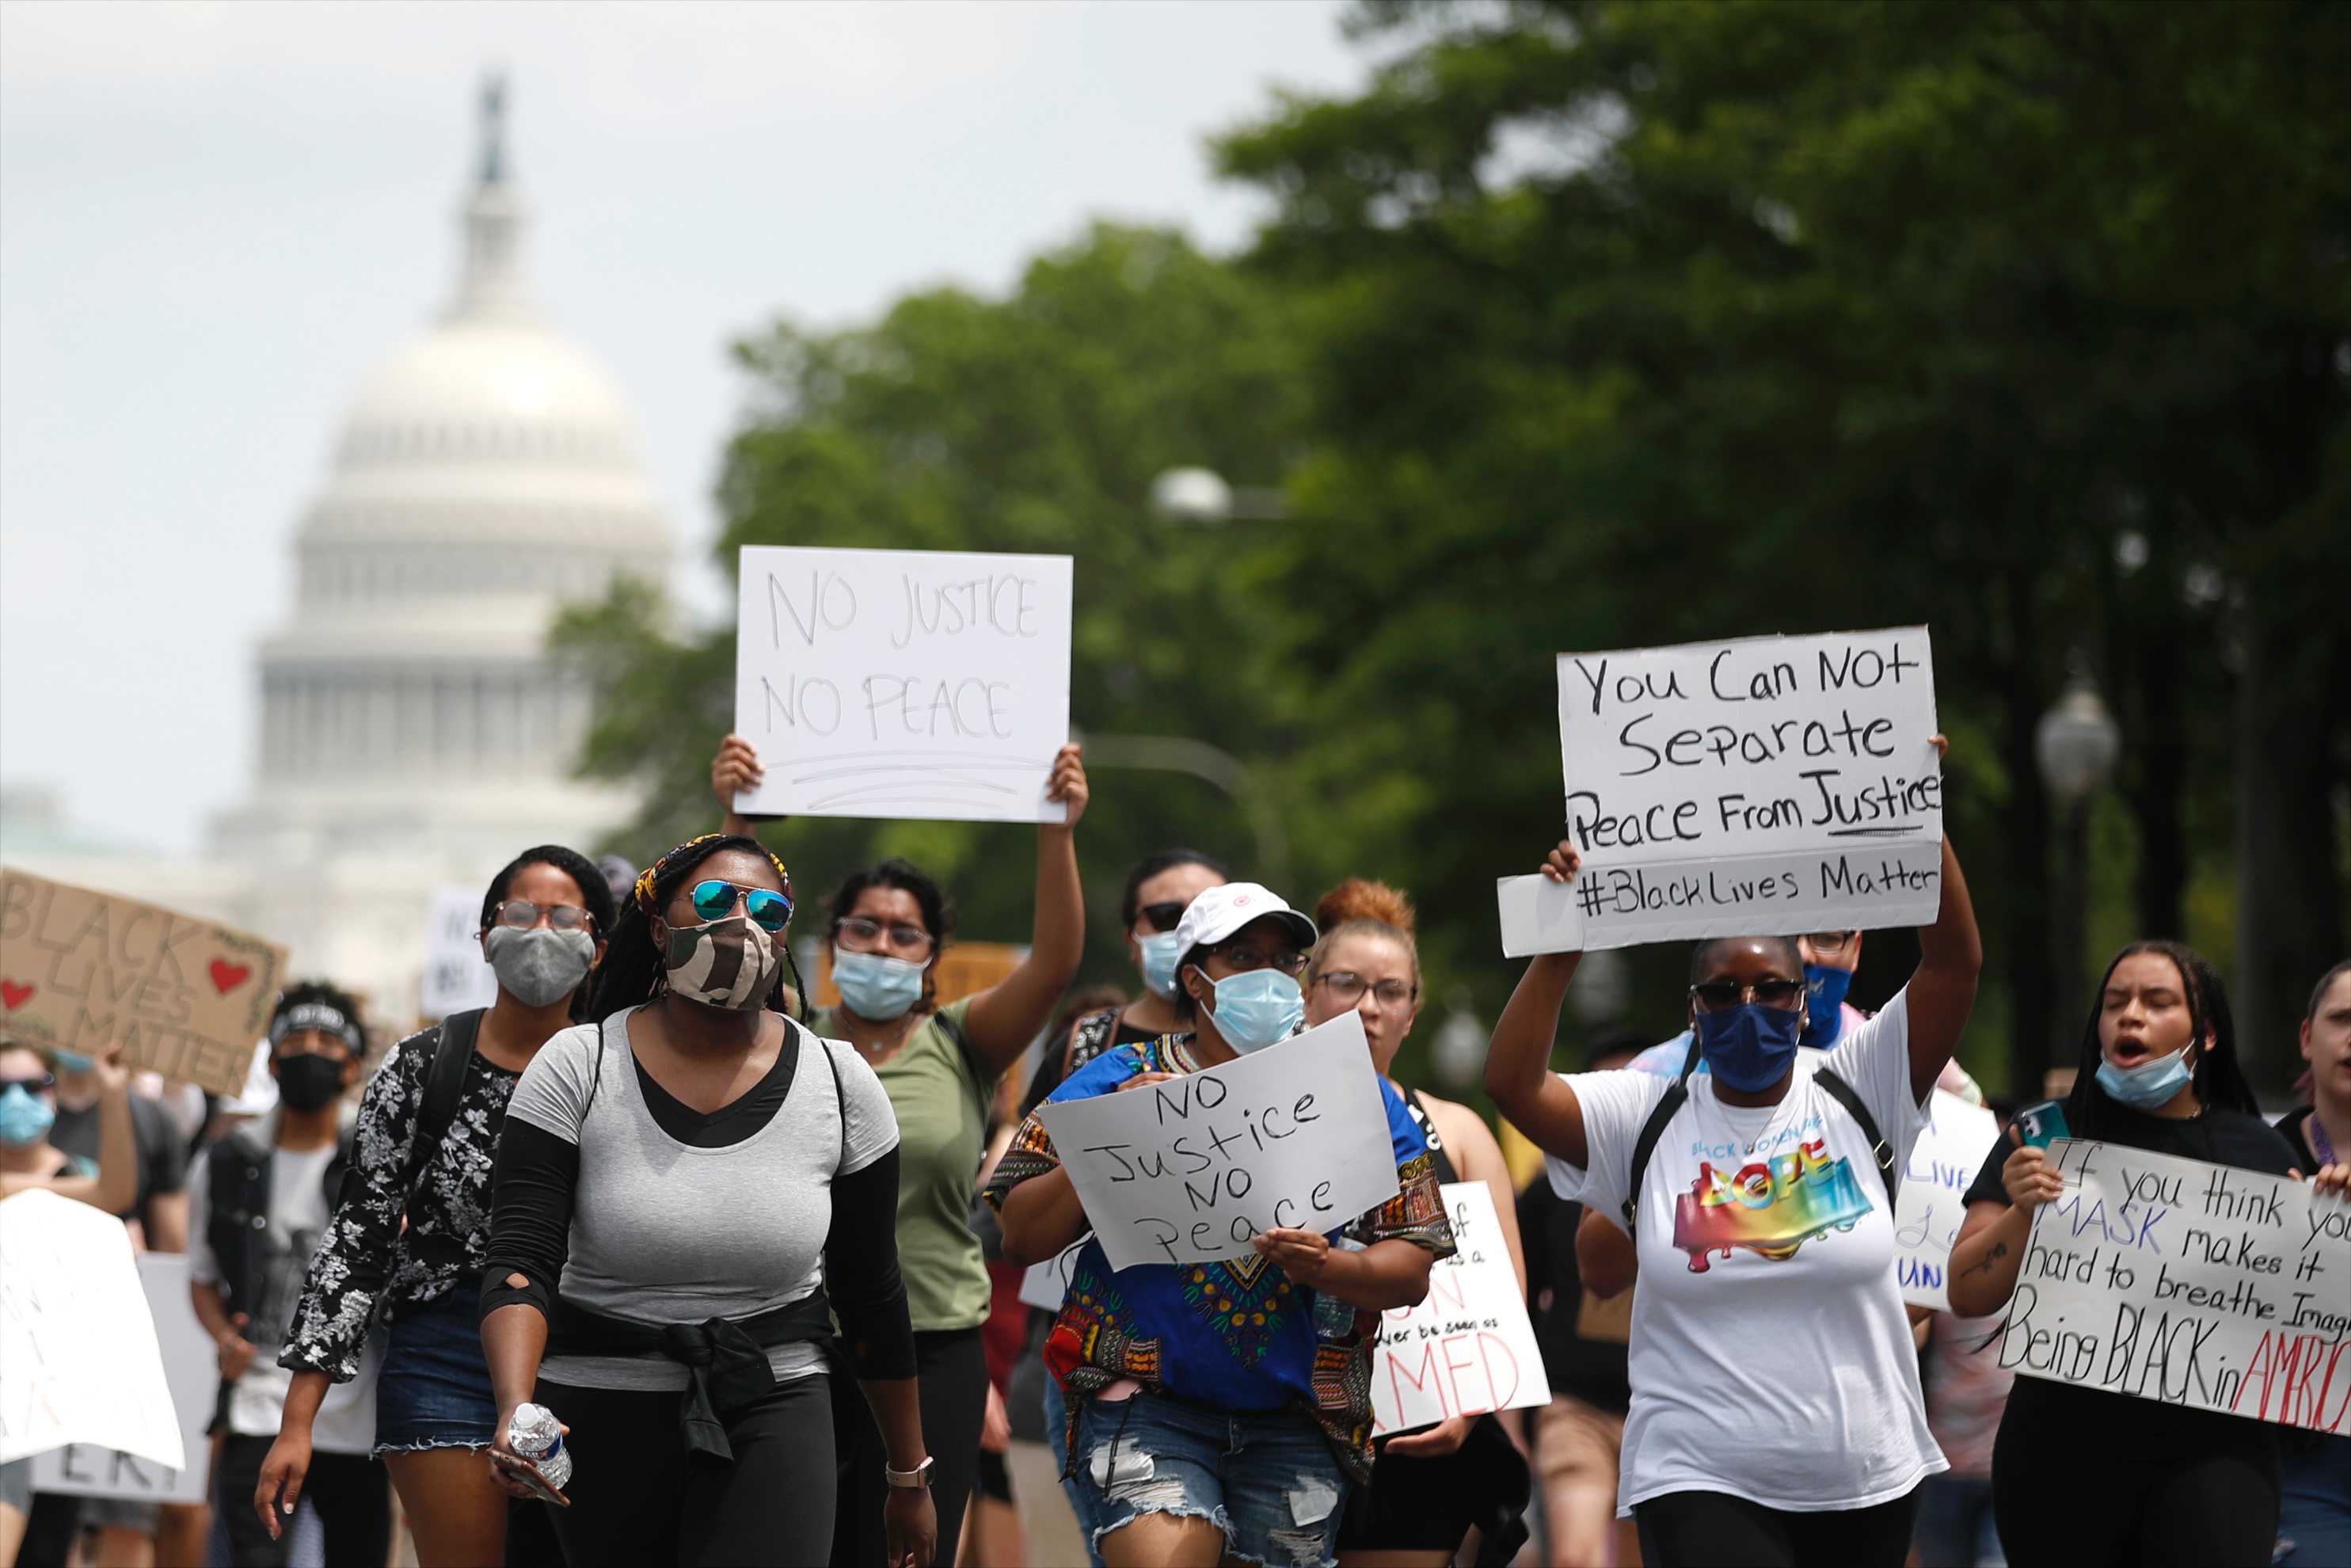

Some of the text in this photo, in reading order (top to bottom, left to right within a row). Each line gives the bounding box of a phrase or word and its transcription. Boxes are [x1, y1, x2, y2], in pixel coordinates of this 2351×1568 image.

[767, 570, 1037, 649] NO JUSTICE
[762, 673, 1013, 740] NO PEACE
[1575, 658, 1689, 715] You
[1710, 649, 1797, 701] Can
[1619, 709, 1896, 776] Separate
[1566, 768, 1942, 851] Peace From Justice
[1820, 856, 1940, 899] Matter
[0, 876, 202, 984] BLACK
[50, 949, 198, 1024] LIVES
[1082, 1093, 1320, 1182] Justice
[1155, 1075, 1227, 1126] NO
[1184, 1167, 1253, 1212] NO
[1700, 1137, 1835, 1210] DOPE
[2055, 1139, 2103, 1189] If
[2121, 1167, 2184, 1215] you
[2202, 1168, 2286, 1227] think
[1134, 1180, 1334, 1262] Peace
[2034, 1193, 2326, 1282] MASK makes it
[2024, 1228, 2099, 1284] hard
[2105, 1250, 2135, 1290] to
[2154, 1262, 2277, 1320] breathe
[1418, 1323, 1440, 1339] be
[1445, 1320, 1478, 1334] seen
[1998, 1282, 2100, 1383] Being
[2101, 1301, 2220, 1406] BLACK
[2213, 1355, 2240, 1410] in
[1374, 1332, 1519, 1431] MED
